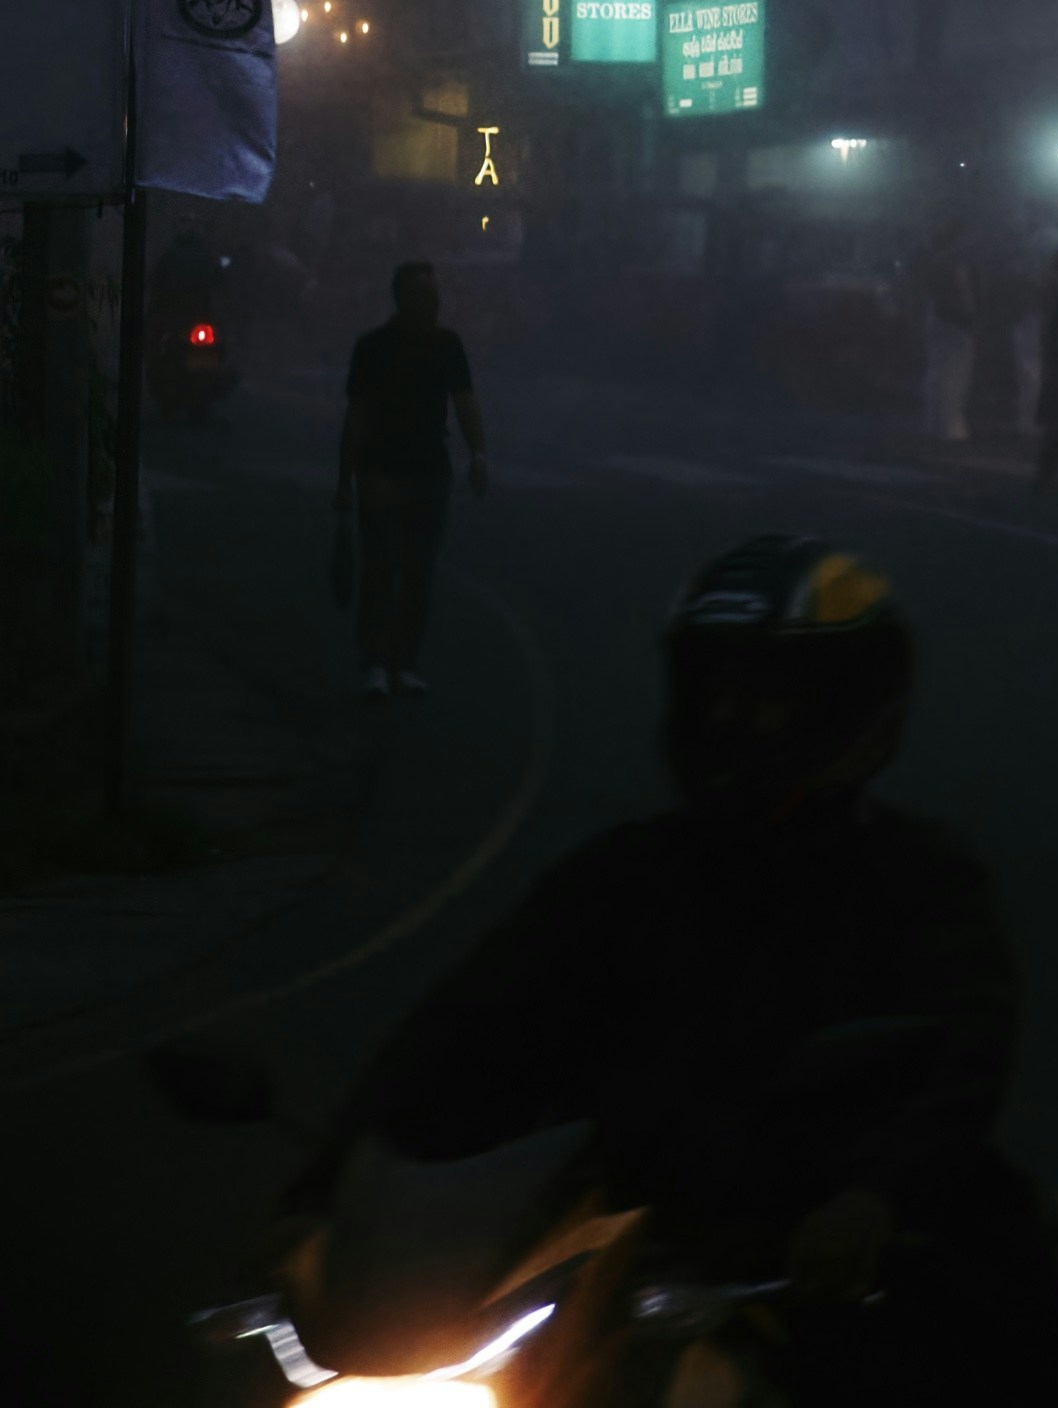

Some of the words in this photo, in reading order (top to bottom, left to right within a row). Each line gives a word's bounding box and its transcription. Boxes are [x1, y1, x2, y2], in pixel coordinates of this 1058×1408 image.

[576, 2, 652, 20] STORES
[669, 10, 694, 33] ELLA
[695, 7, 721, 29] WINE
[722, 2, 758, 27] STORES
